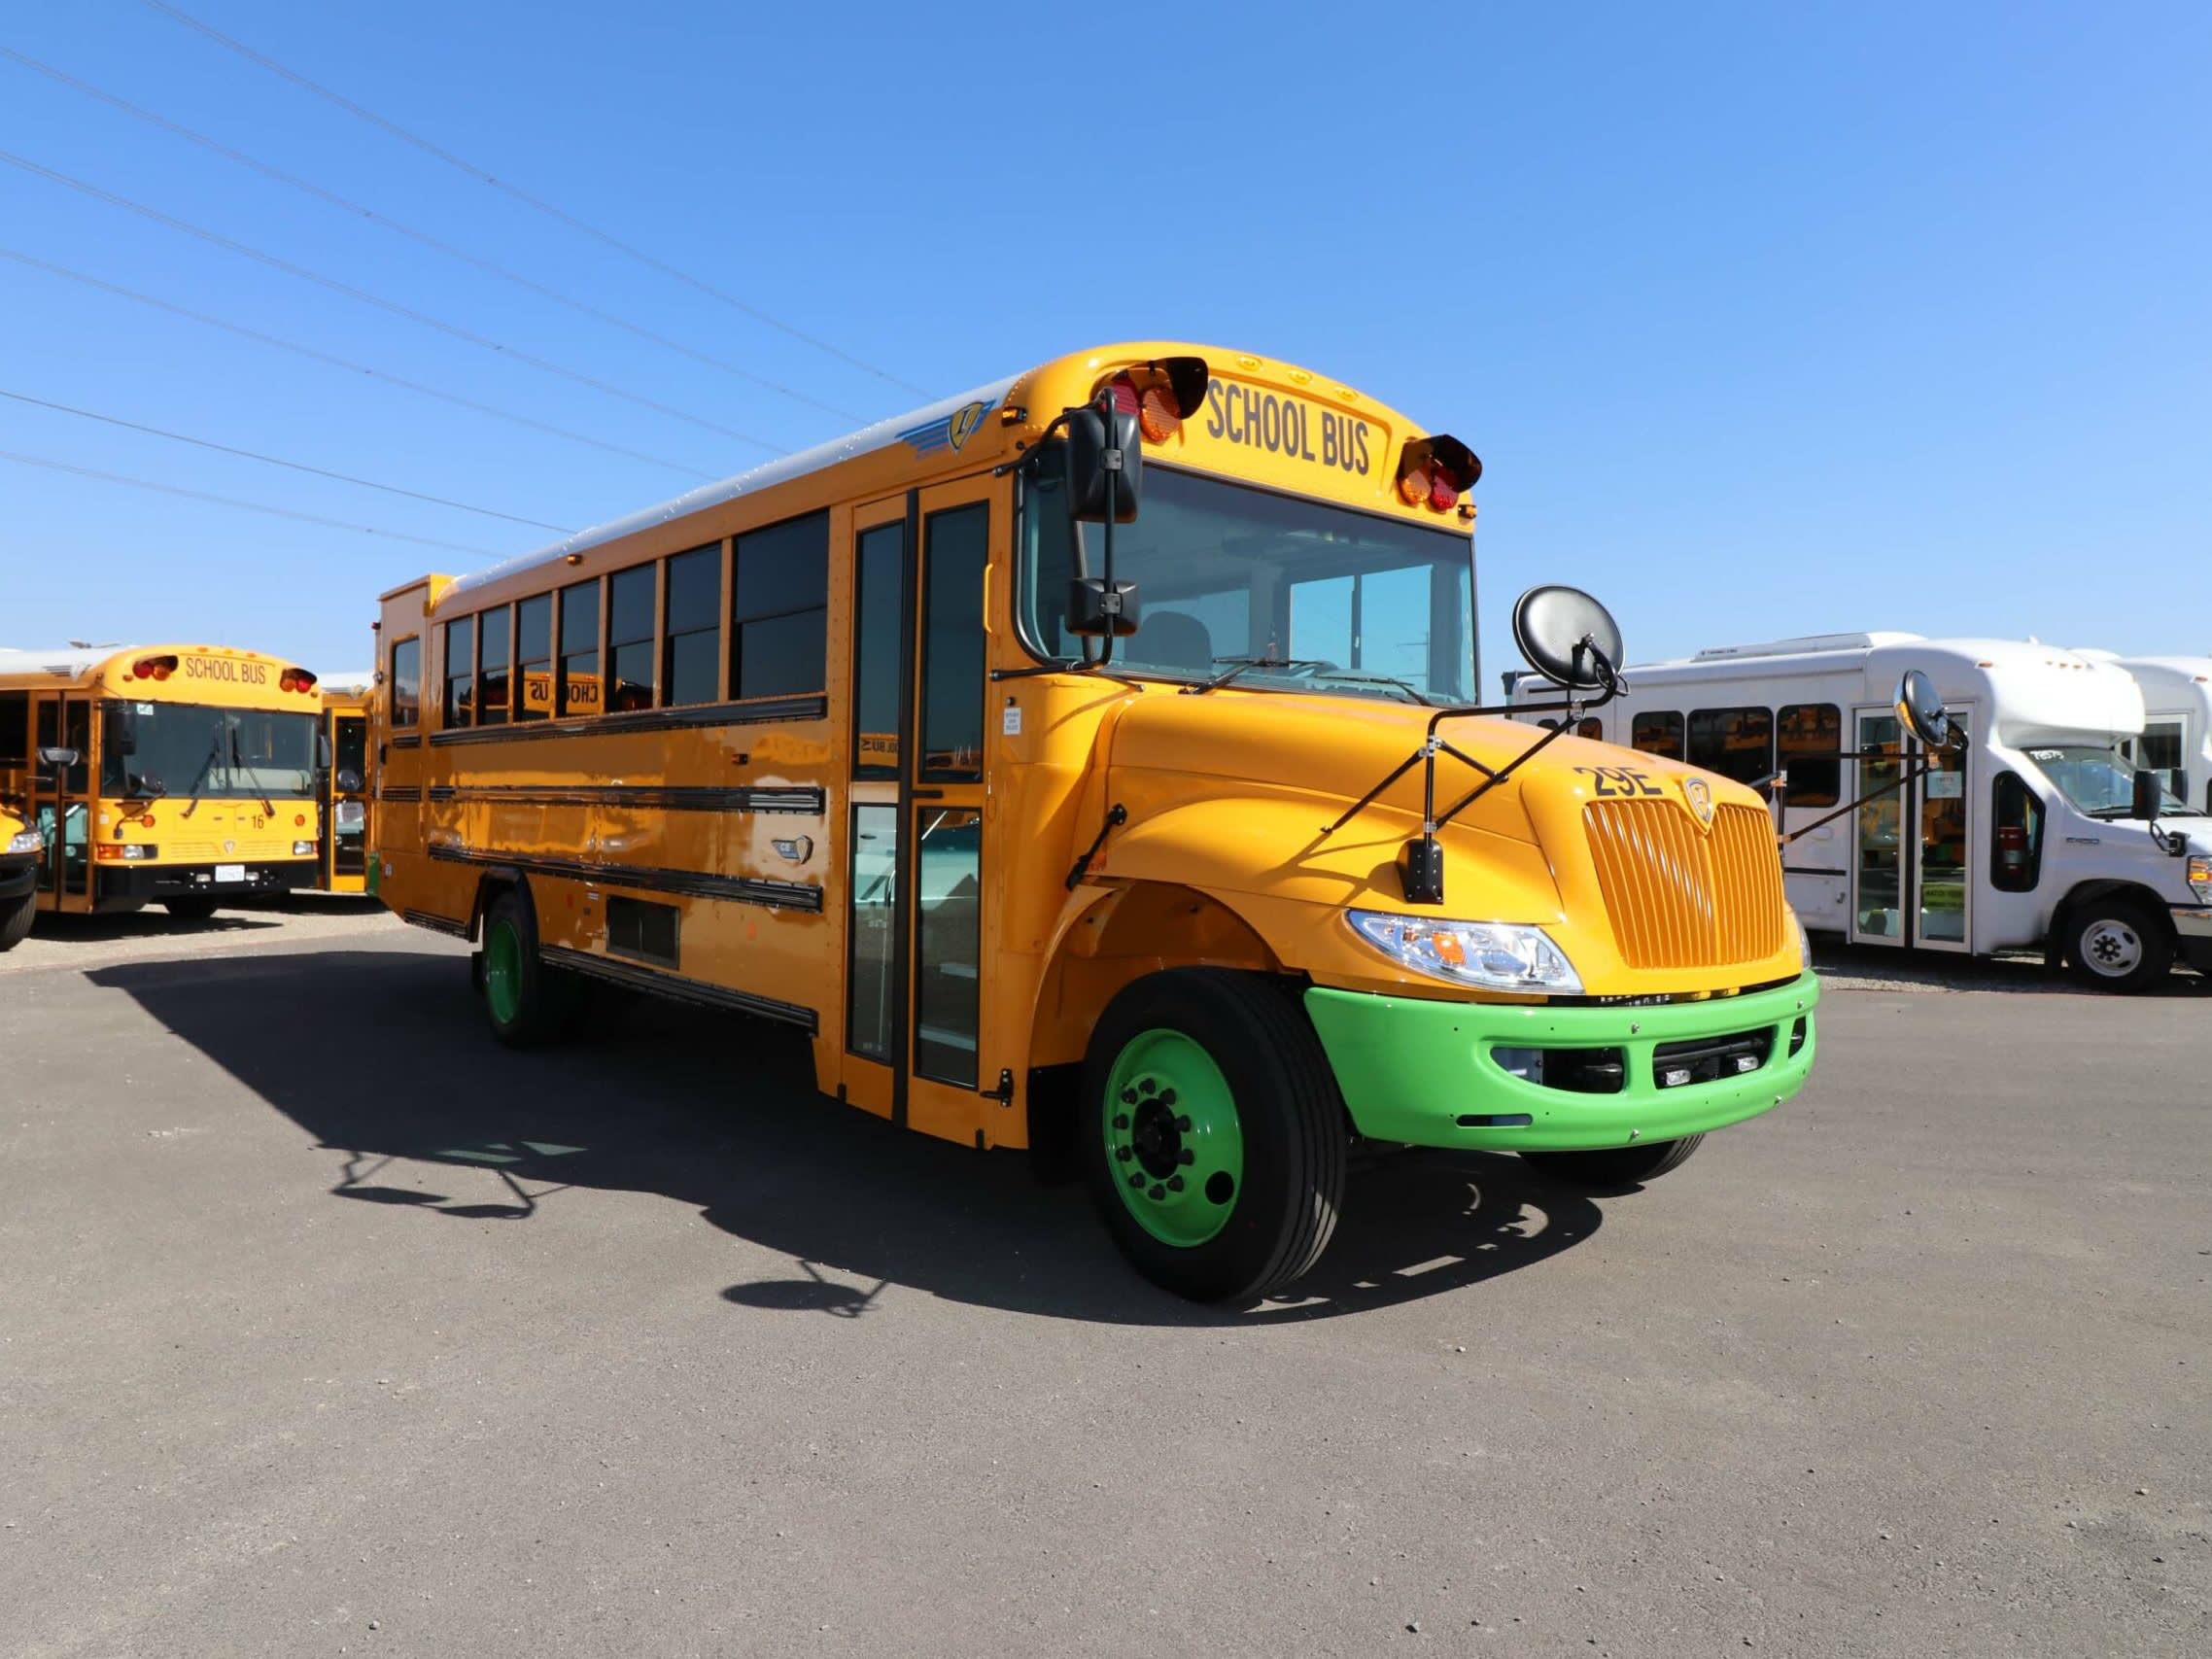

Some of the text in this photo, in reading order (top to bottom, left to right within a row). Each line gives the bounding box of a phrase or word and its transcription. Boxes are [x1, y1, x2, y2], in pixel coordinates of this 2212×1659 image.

[1206, 378, 1369, 476] SCHOOL BUS
[186, 657, 265, 684] SCHOOL BUS
[1573, 766, 1663, 796] 29E
[252, 814, 264, 829] 16
